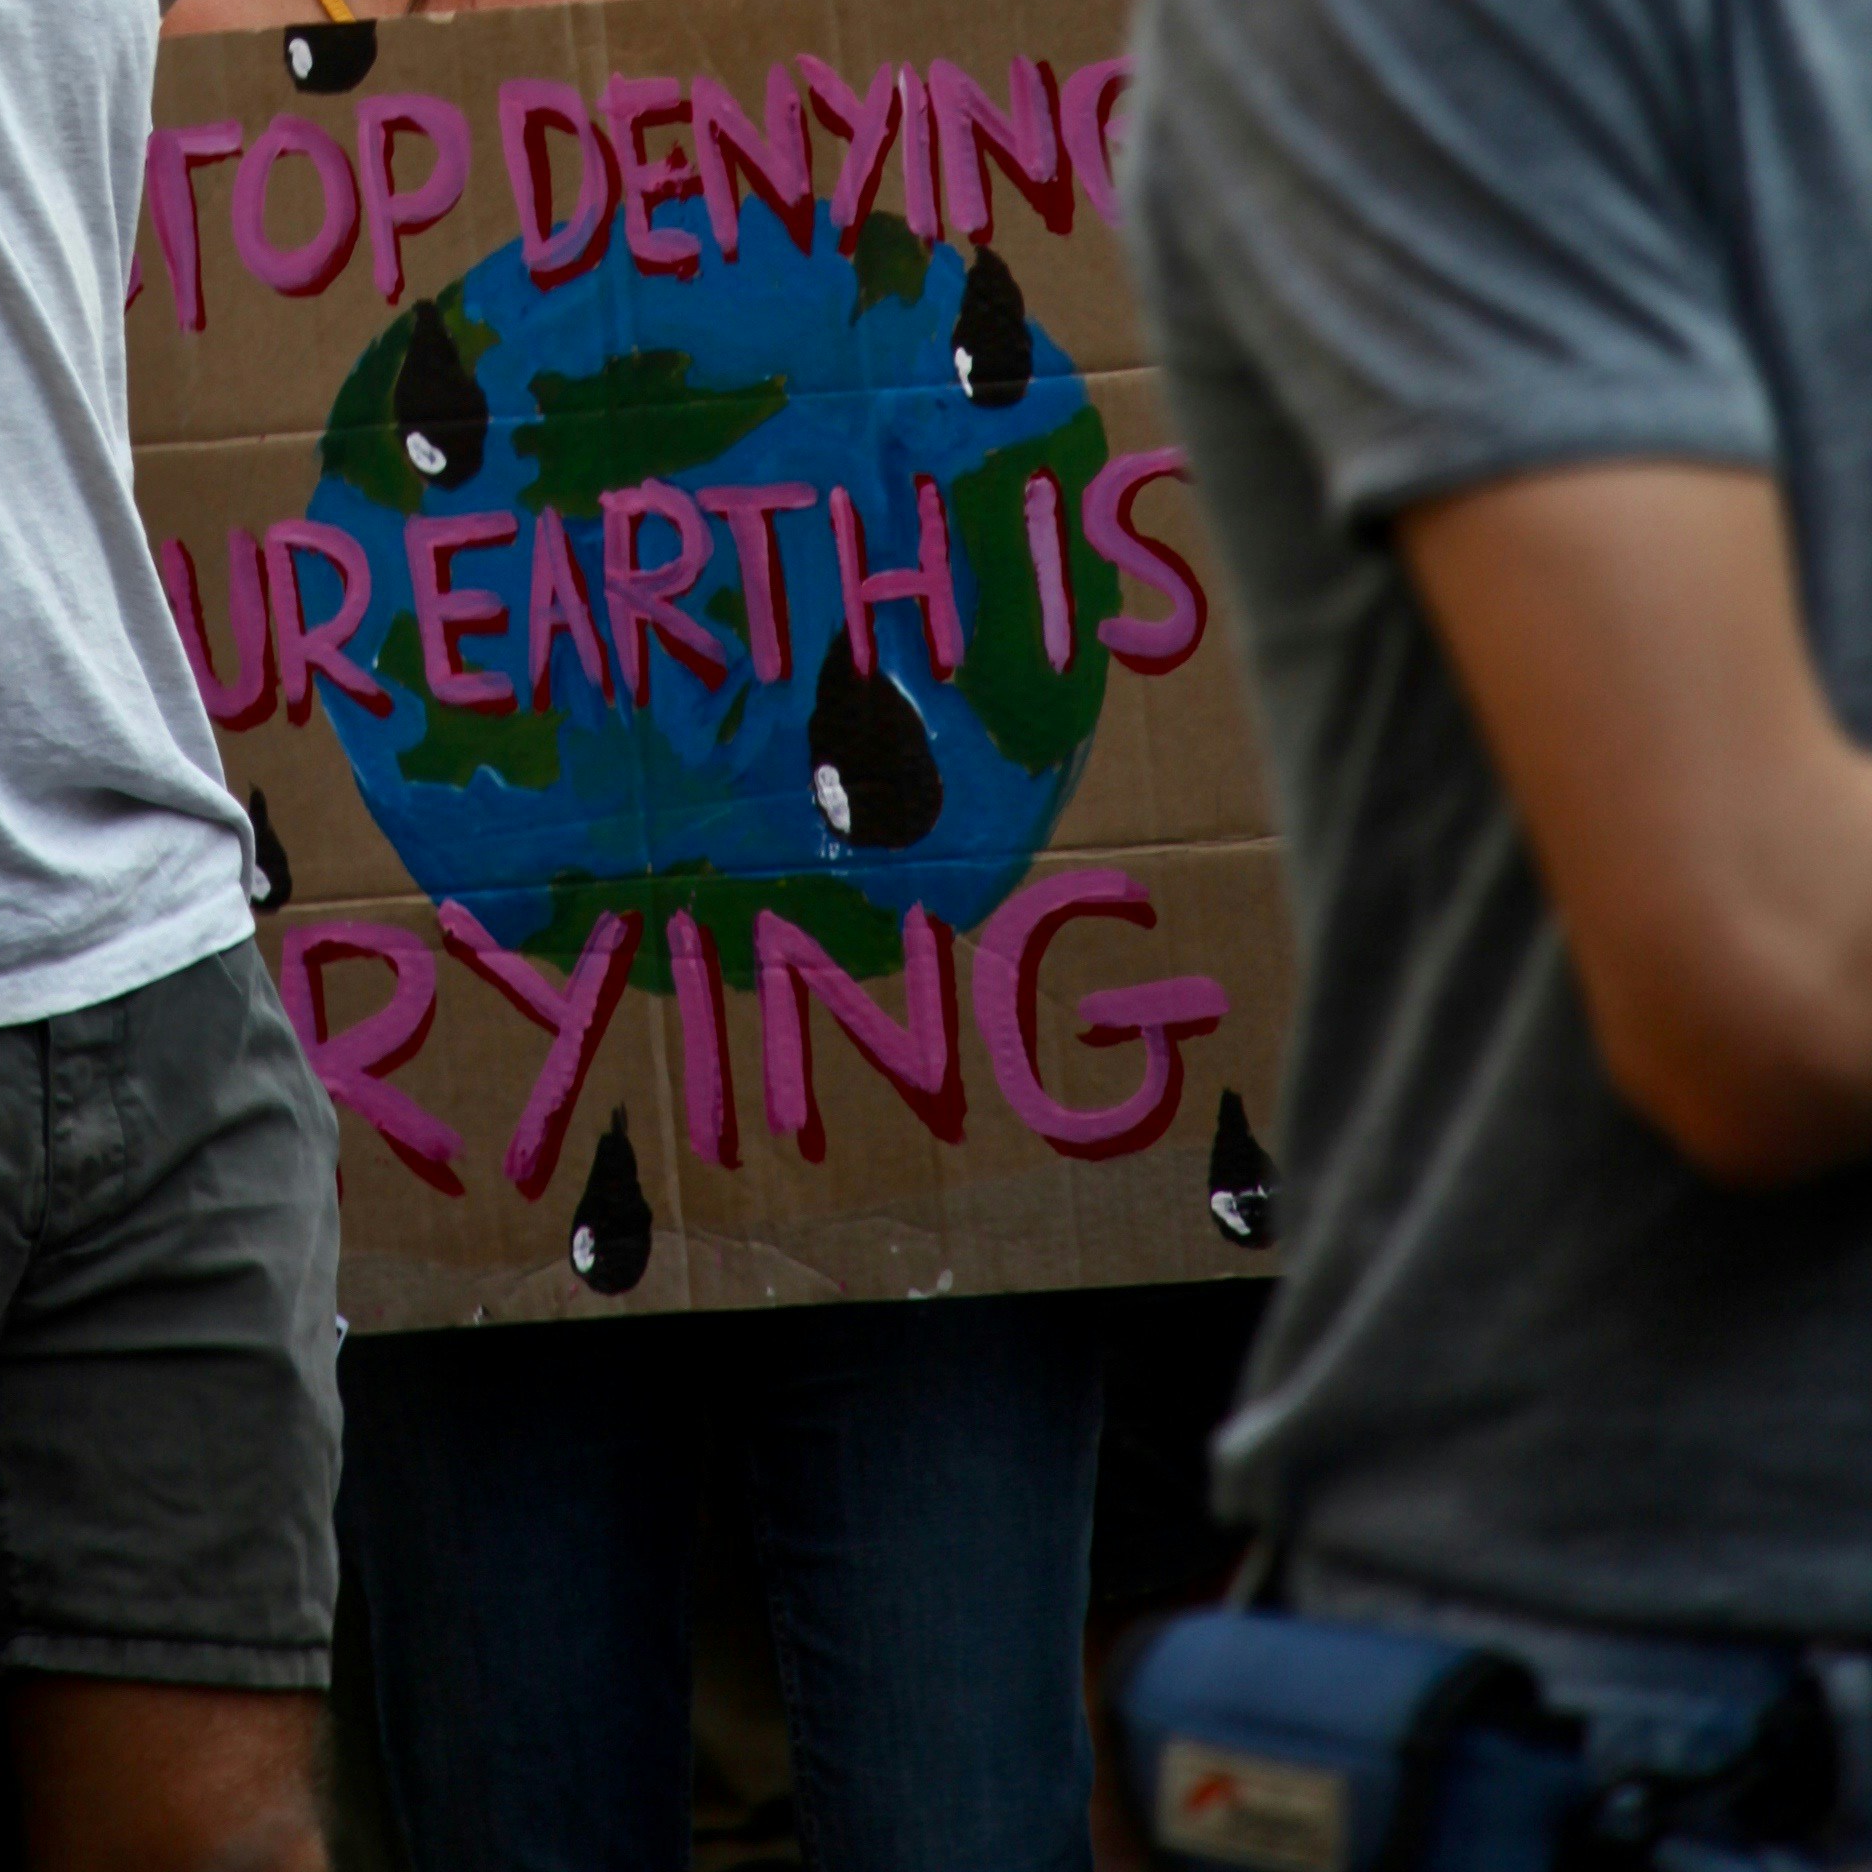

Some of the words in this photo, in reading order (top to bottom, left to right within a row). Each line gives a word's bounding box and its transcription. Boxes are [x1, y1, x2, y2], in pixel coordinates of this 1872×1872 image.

[125, 94, 472, 333] TOP
[161, 520, 393, 730] UR
[405, 478, 964, 717] EARTH
[1024, 446, 1207, 677] IS
[278, 864, 1231, 1201] RYING
